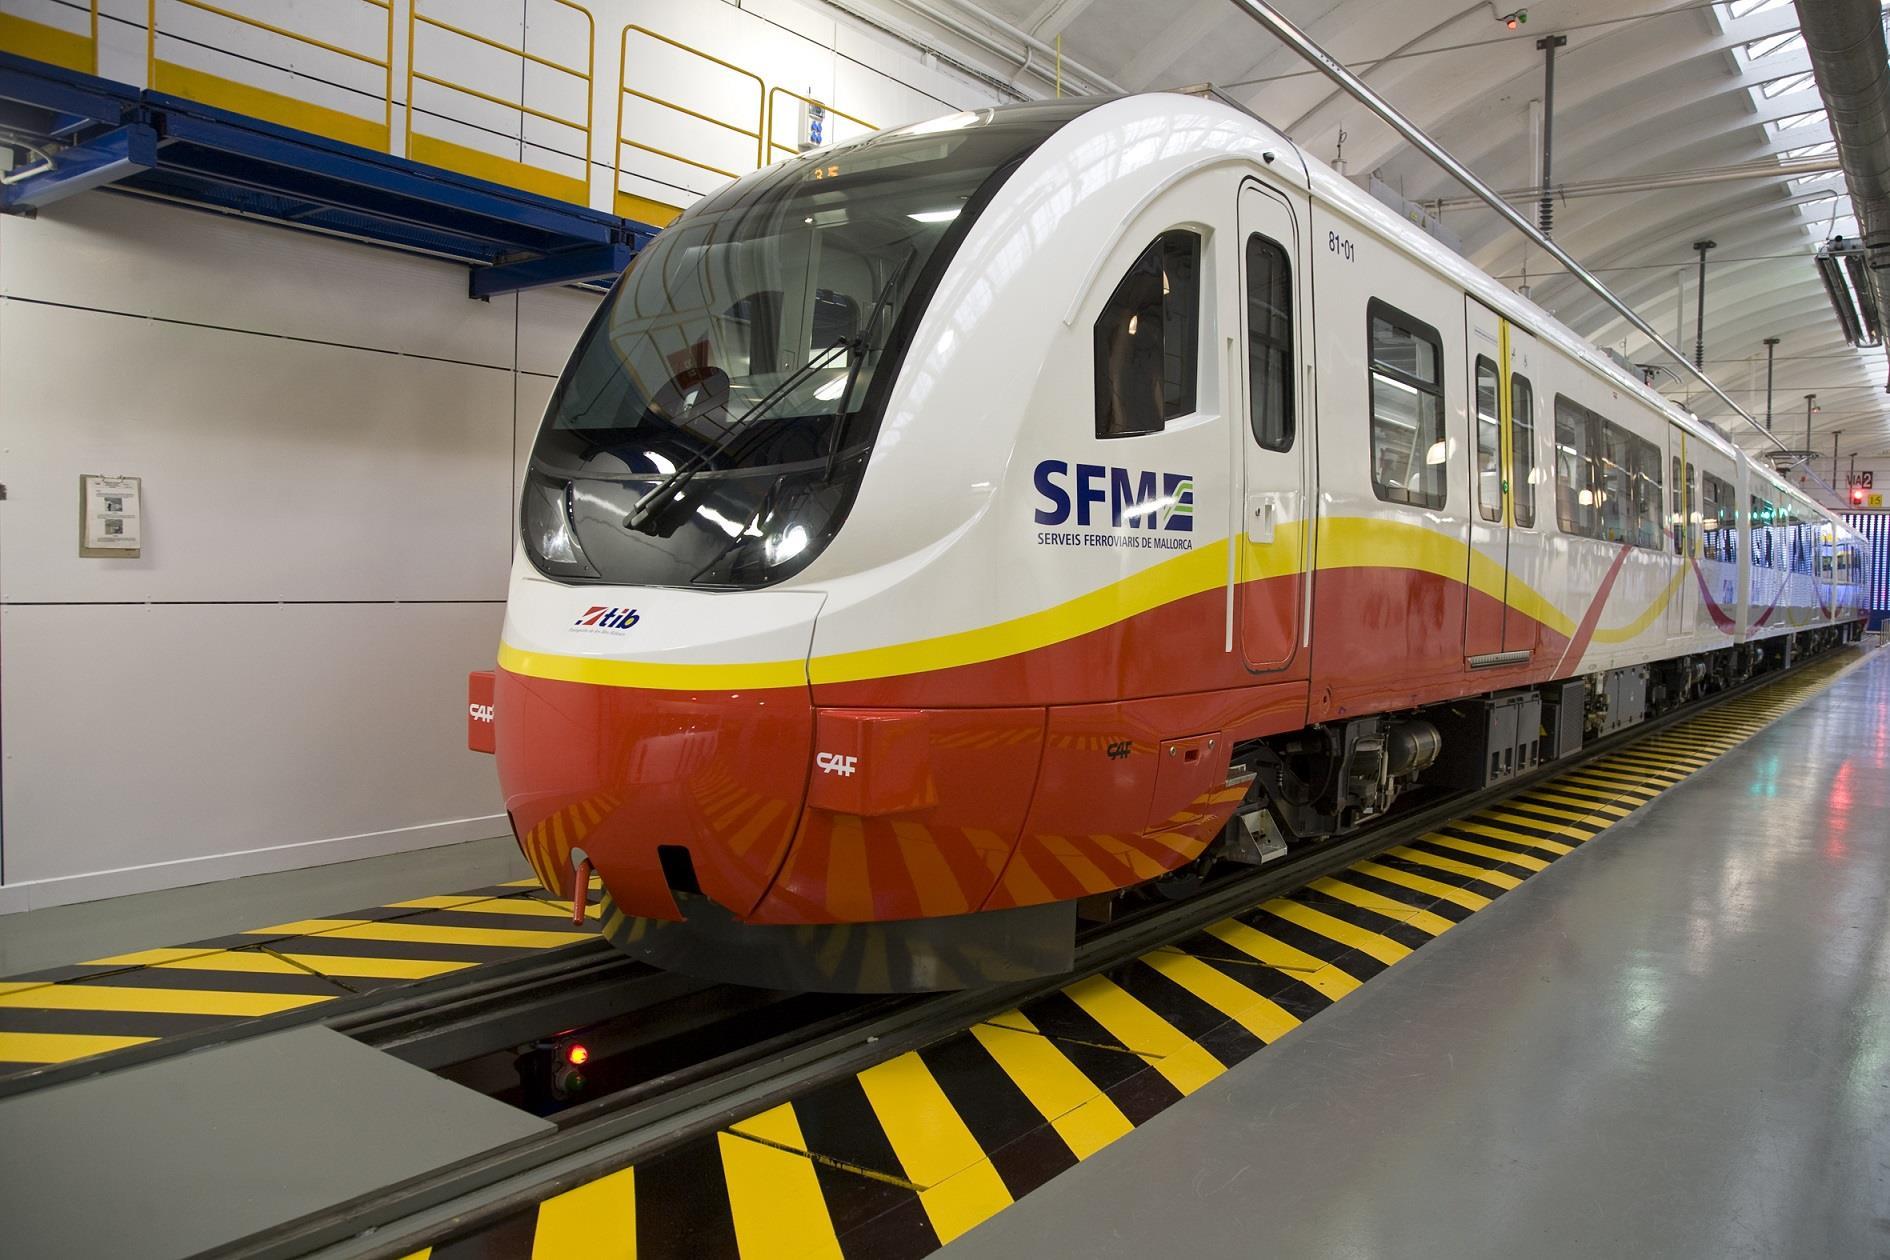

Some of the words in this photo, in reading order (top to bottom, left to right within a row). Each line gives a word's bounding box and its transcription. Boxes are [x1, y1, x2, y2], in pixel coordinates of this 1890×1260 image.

[1033, 459, 1157, 530] SFM
[1038, 532, 1081, 546] SERVEIS
[1083, 534, 1140, 549] FERROVIARIS
[1141, 537, 1152, 549] DE
[1153, 537, 1193, 551] MALLORCA
[598, 607, 640, 629] tib
[816, 752, 858, 777] CAF
